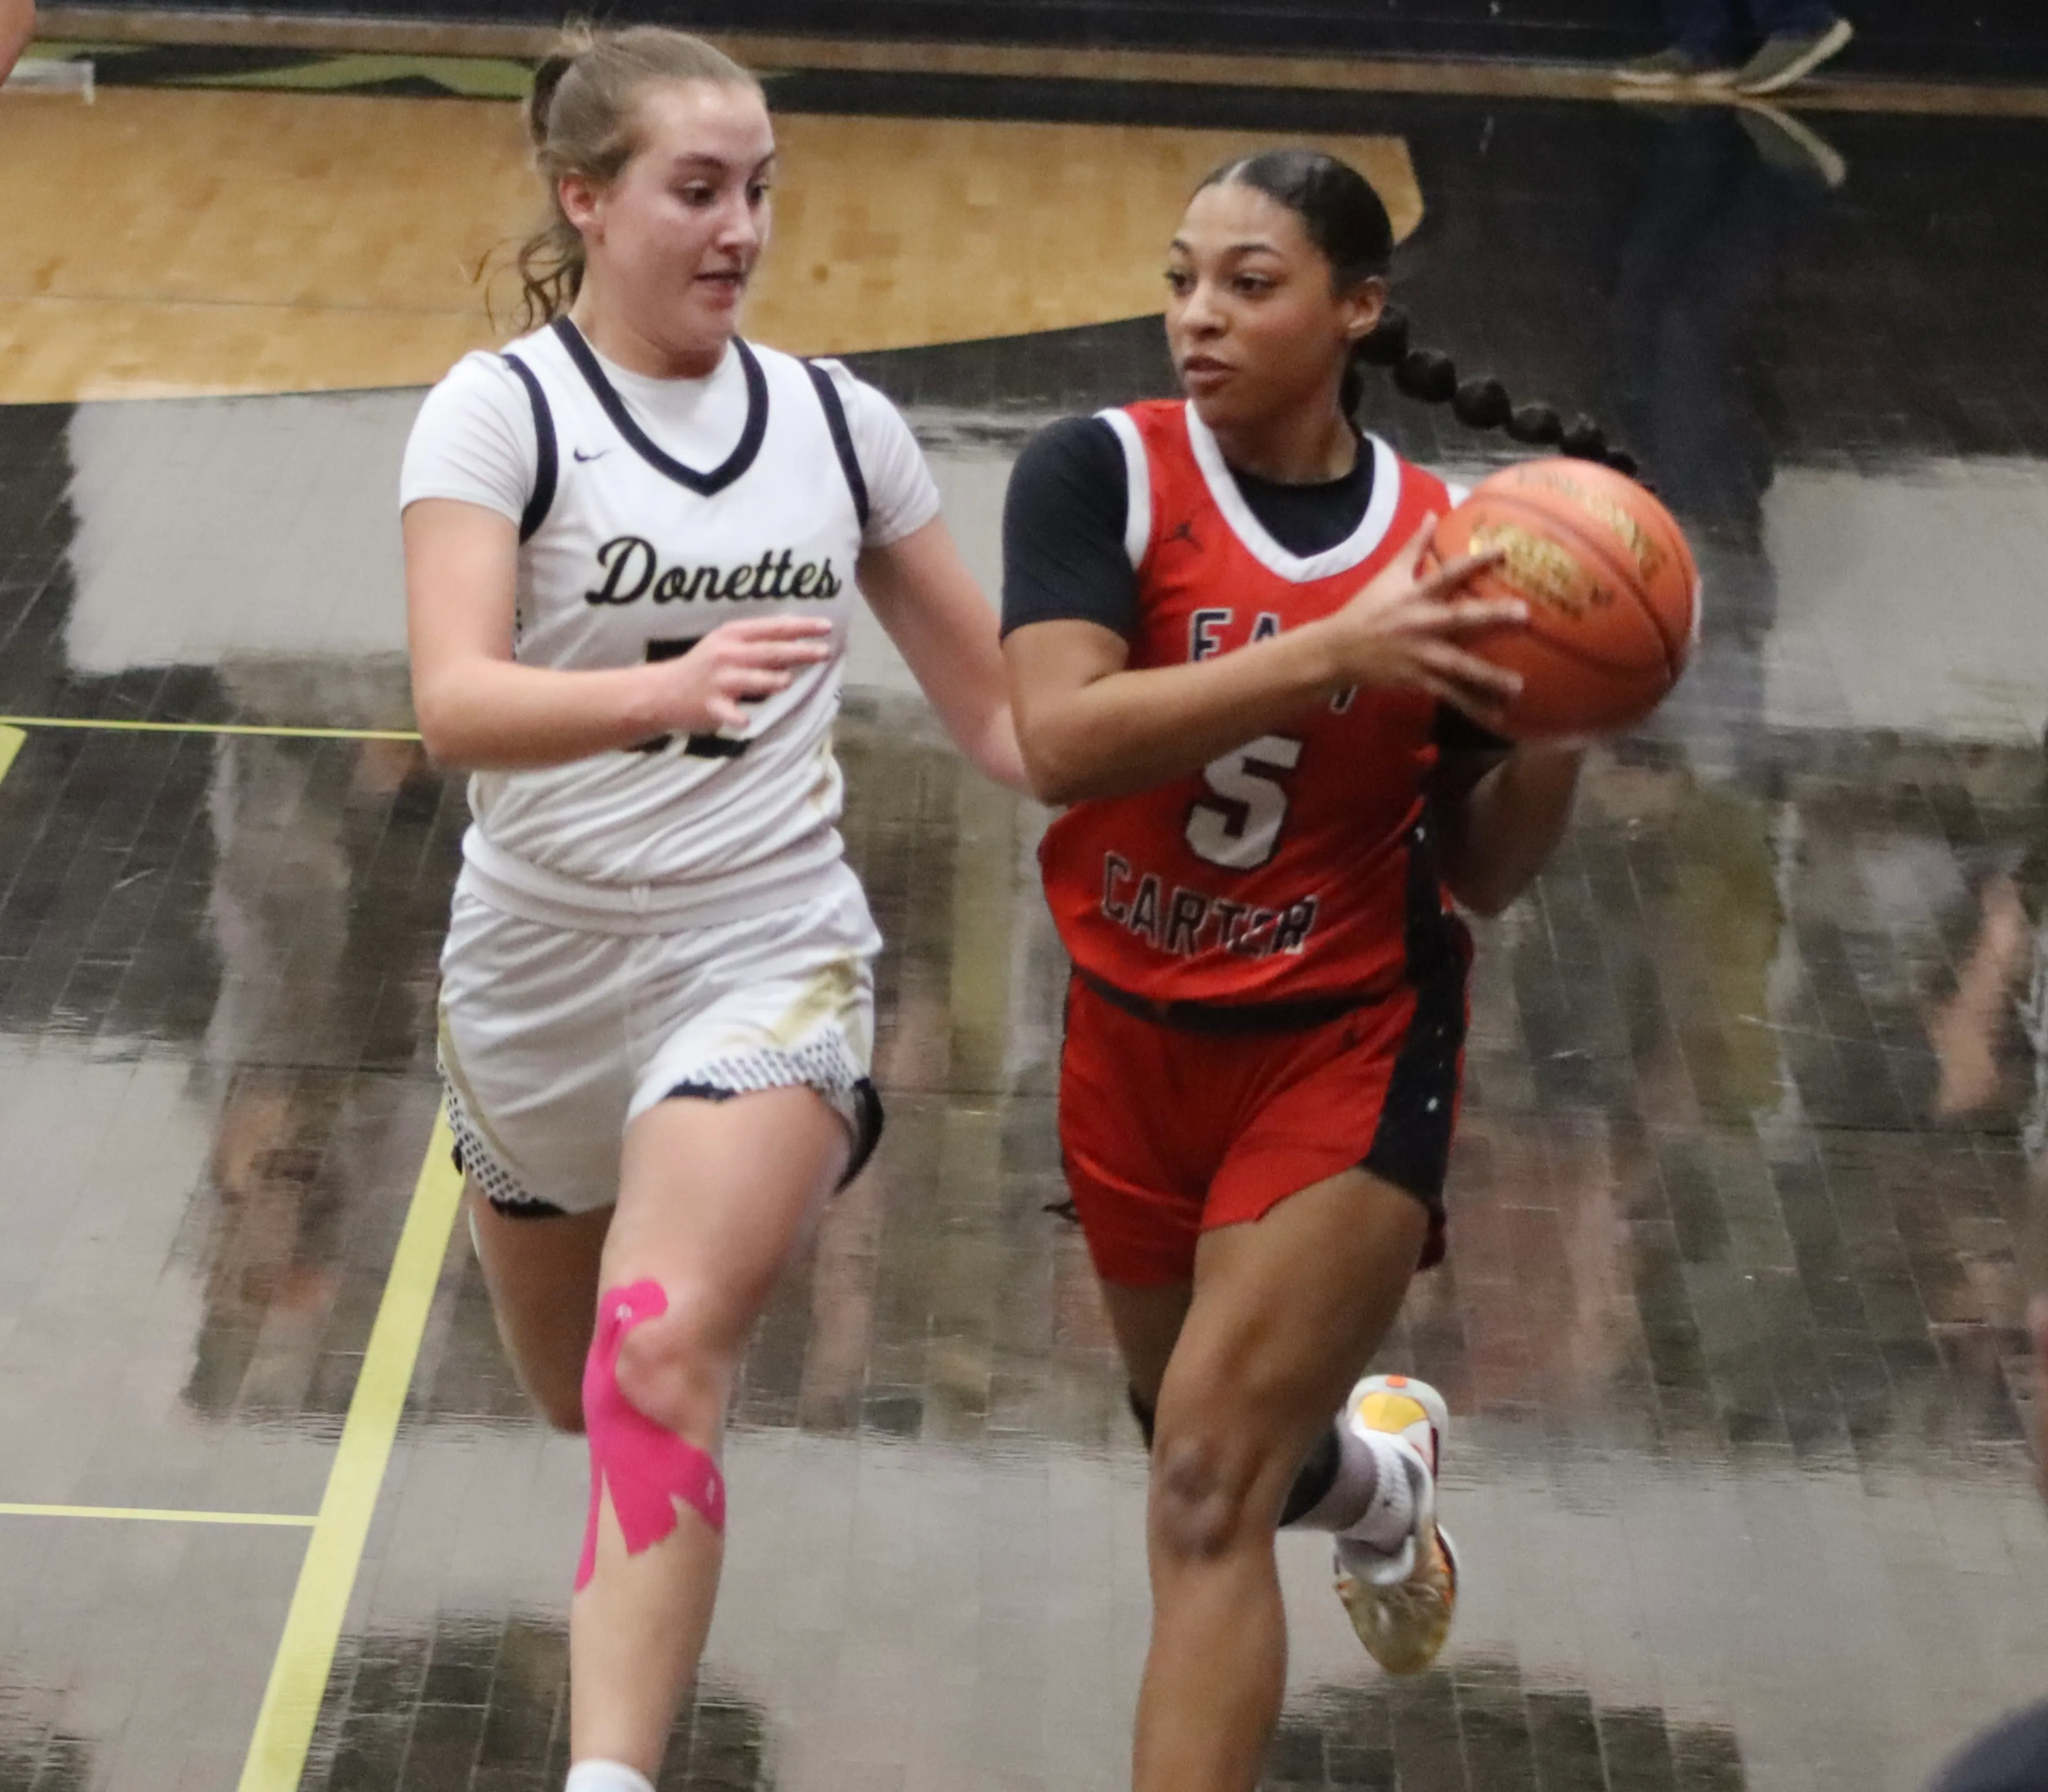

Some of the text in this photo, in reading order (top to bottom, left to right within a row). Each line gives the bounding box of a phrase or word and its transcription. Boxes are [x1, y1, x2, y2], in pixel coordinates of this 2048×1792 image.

[585, 535, 842, 606] Donettes
[1185, 734, 1303, 870] 5
[1101, 850, 1319, 960] CARTER
